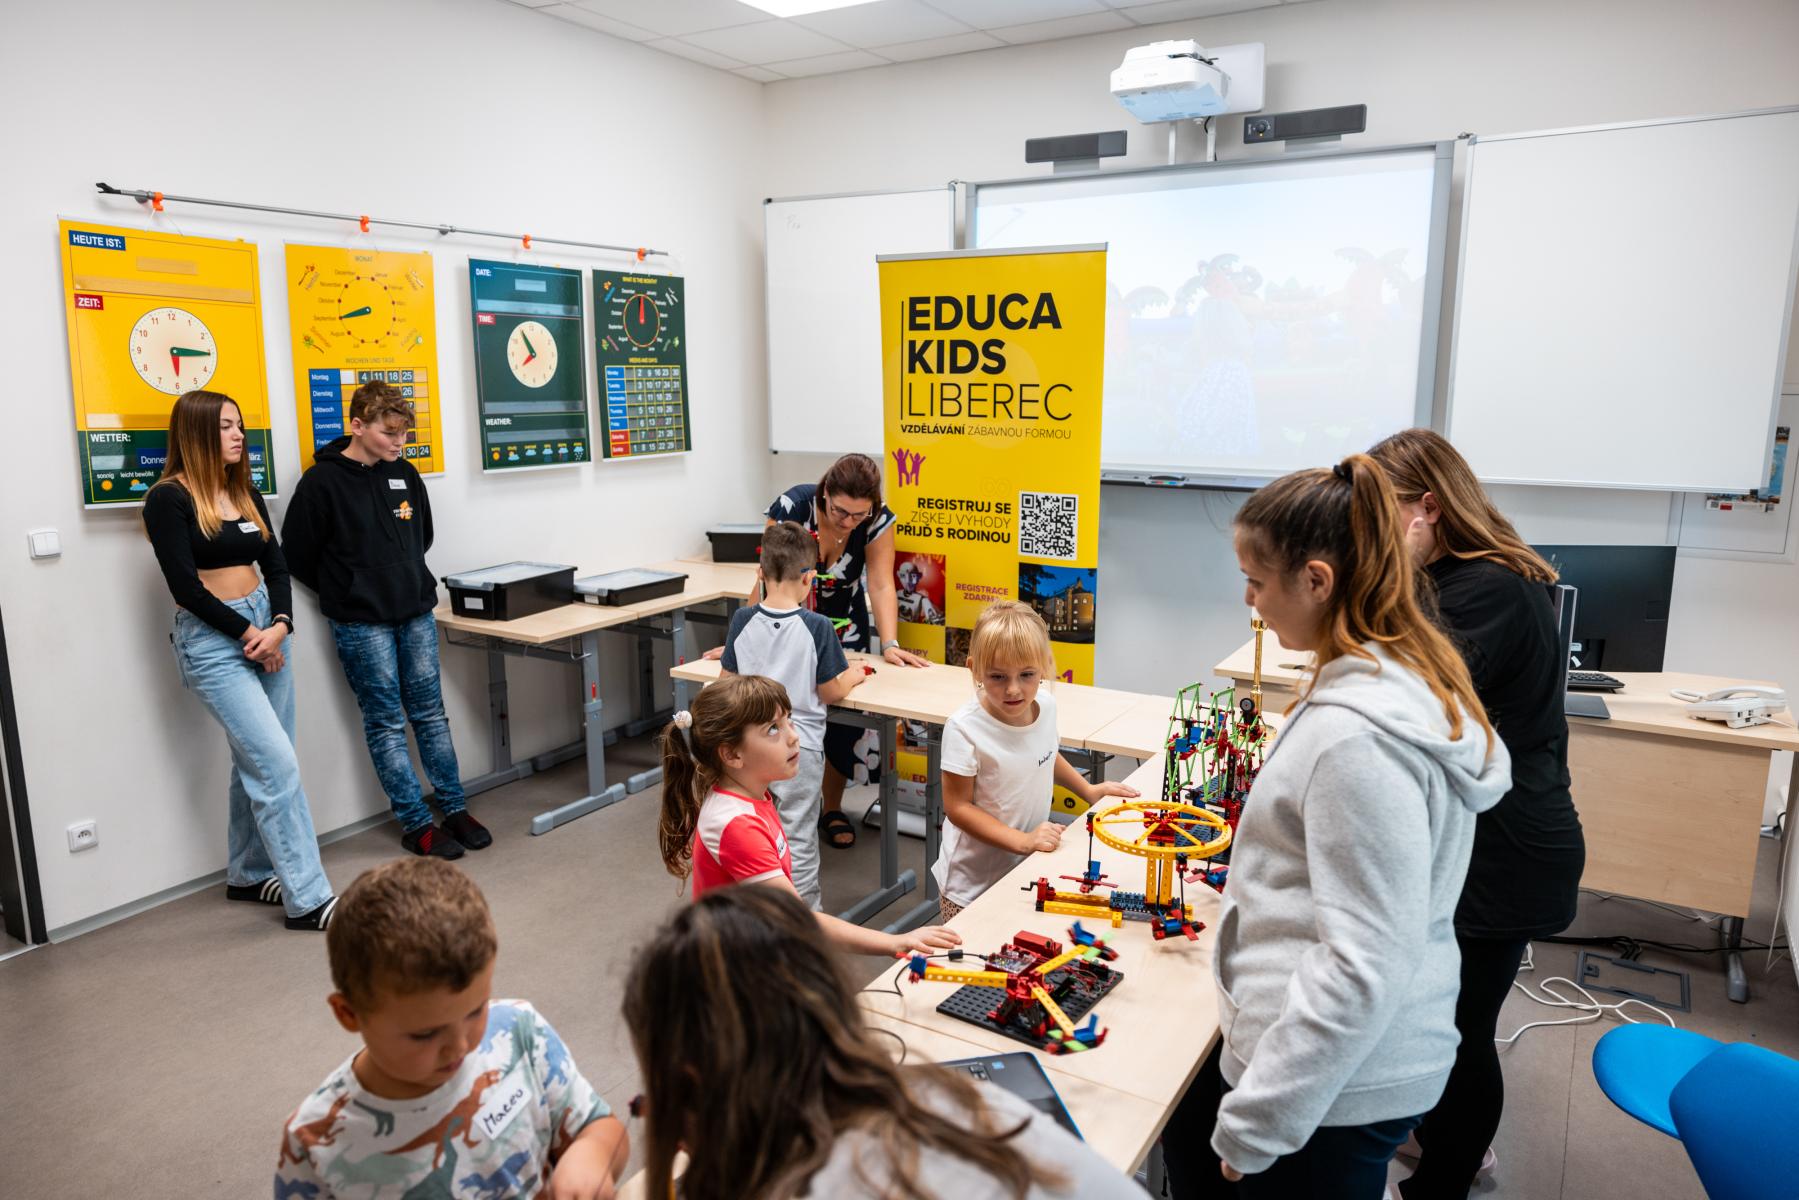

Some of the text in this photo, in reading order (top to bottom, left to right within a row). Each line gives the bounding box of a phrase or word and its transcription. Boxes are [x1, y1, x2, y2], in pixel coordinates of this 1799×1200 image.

[73, 234, 122, 248] HEUTE IST:
[476, 268, 492, 276] DATE:
[78, 297, 100, 308] ZEIT:
[908, 292, 1062, 331] EDUCA
[908, 339, 1006, 375] KIDS
[389, 372, 398, 380] 18
[403, 371, 412, 379] 25
[403, 387, 413, 396] 26
[908, 382, 1072, 421] LIBEREC
[485, 418, 512, 426] WEATHER:
[90, 433, 131, 442] WETTER:
[901, 423, 1071, 439] VZDĚLÁVÁNÍ ZÁBAVNOU FORMOU
[407, 448, 416, 456] 30
[918, 498, 1011, 514] REGISTRUJ SE
[911, 510, 1011, 529] ZÍSKEJ VÝHODY
[896, 522, 1010, 544] PŘIJĎ S RODINOU
[956, 583, 1009, 596] REGISTRACE
